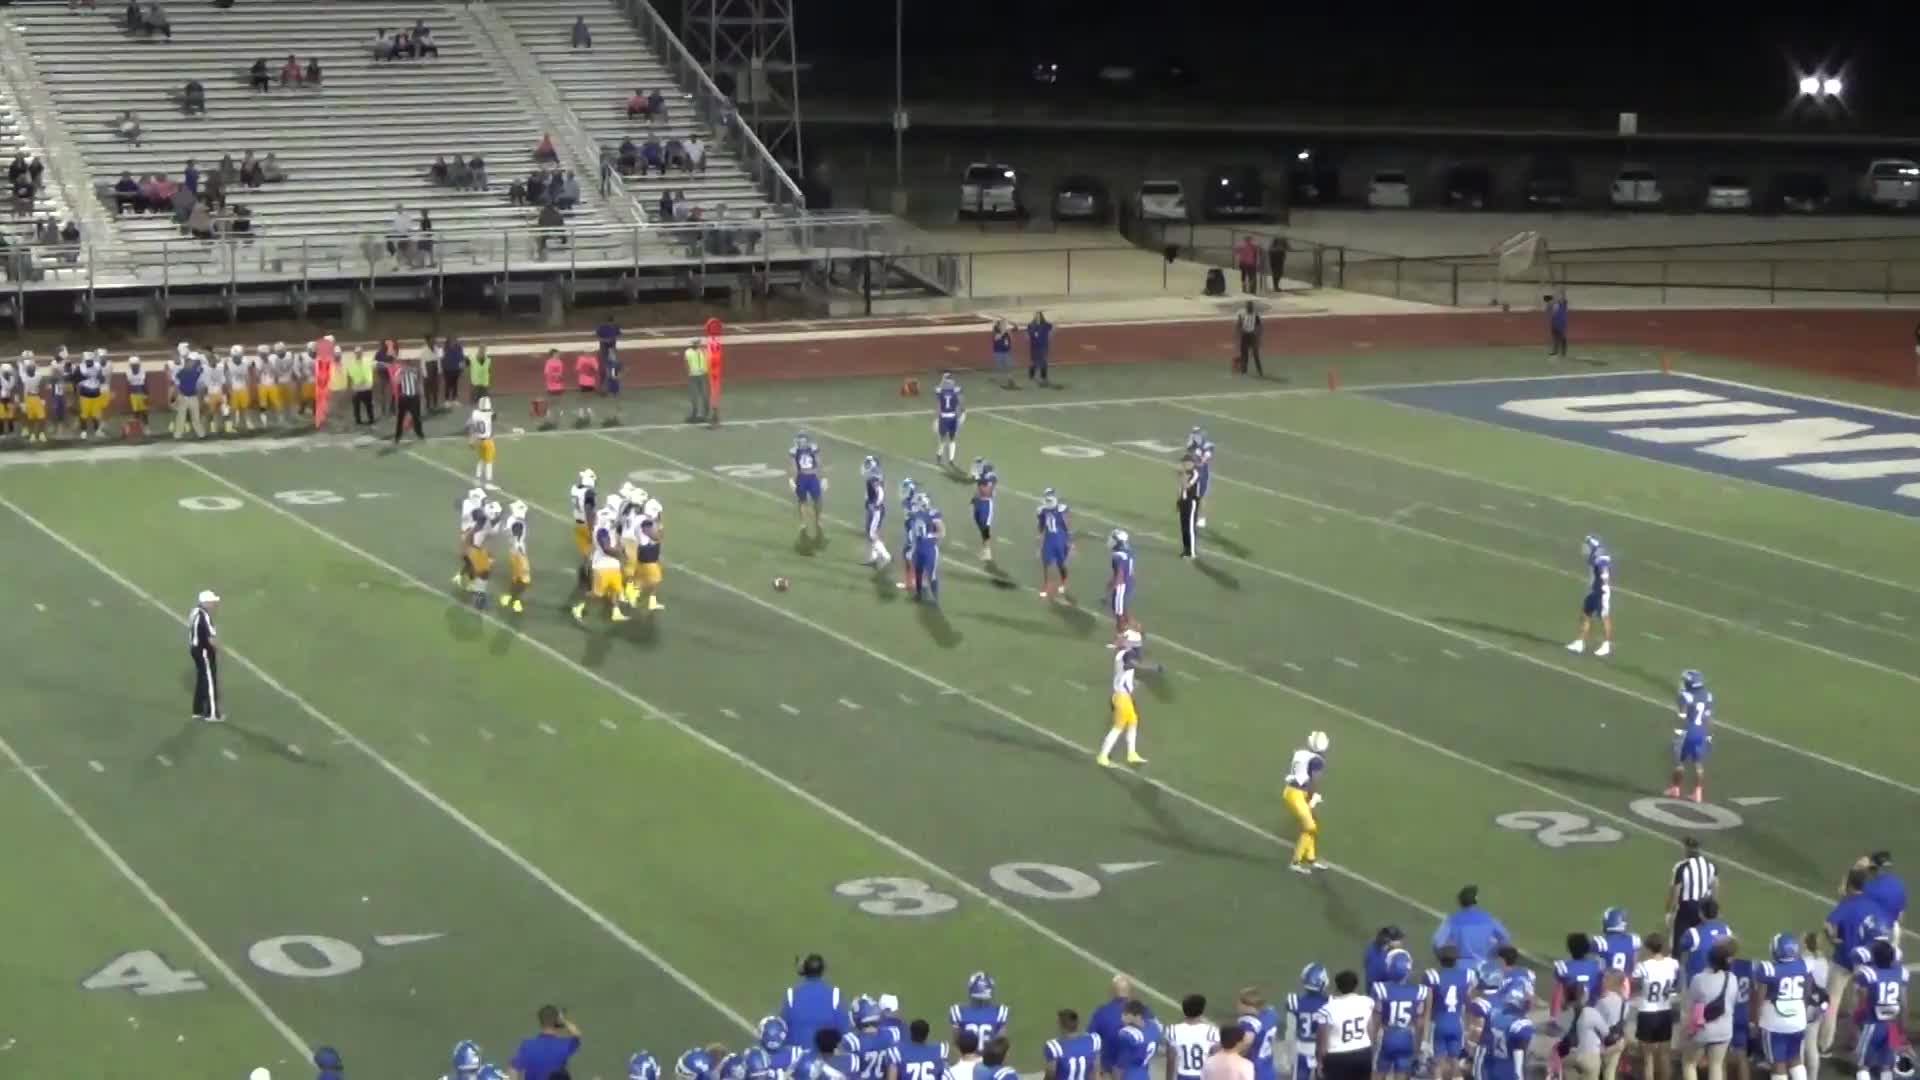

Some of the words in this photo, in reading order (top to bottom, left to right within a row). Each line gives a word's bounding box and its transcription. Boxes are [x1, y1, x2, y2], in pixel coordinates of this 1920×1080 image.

[1444, 986, 1459, 1013] 4
[1878, 981, 1900, 1005] 12
[1389, 1000, 1413, 1028] 15
[1341, 1016, 1365, 1043] 65
[1068, 1055, 1086, 1080] 11
[1181, 1042, 1204, 1070] 18
